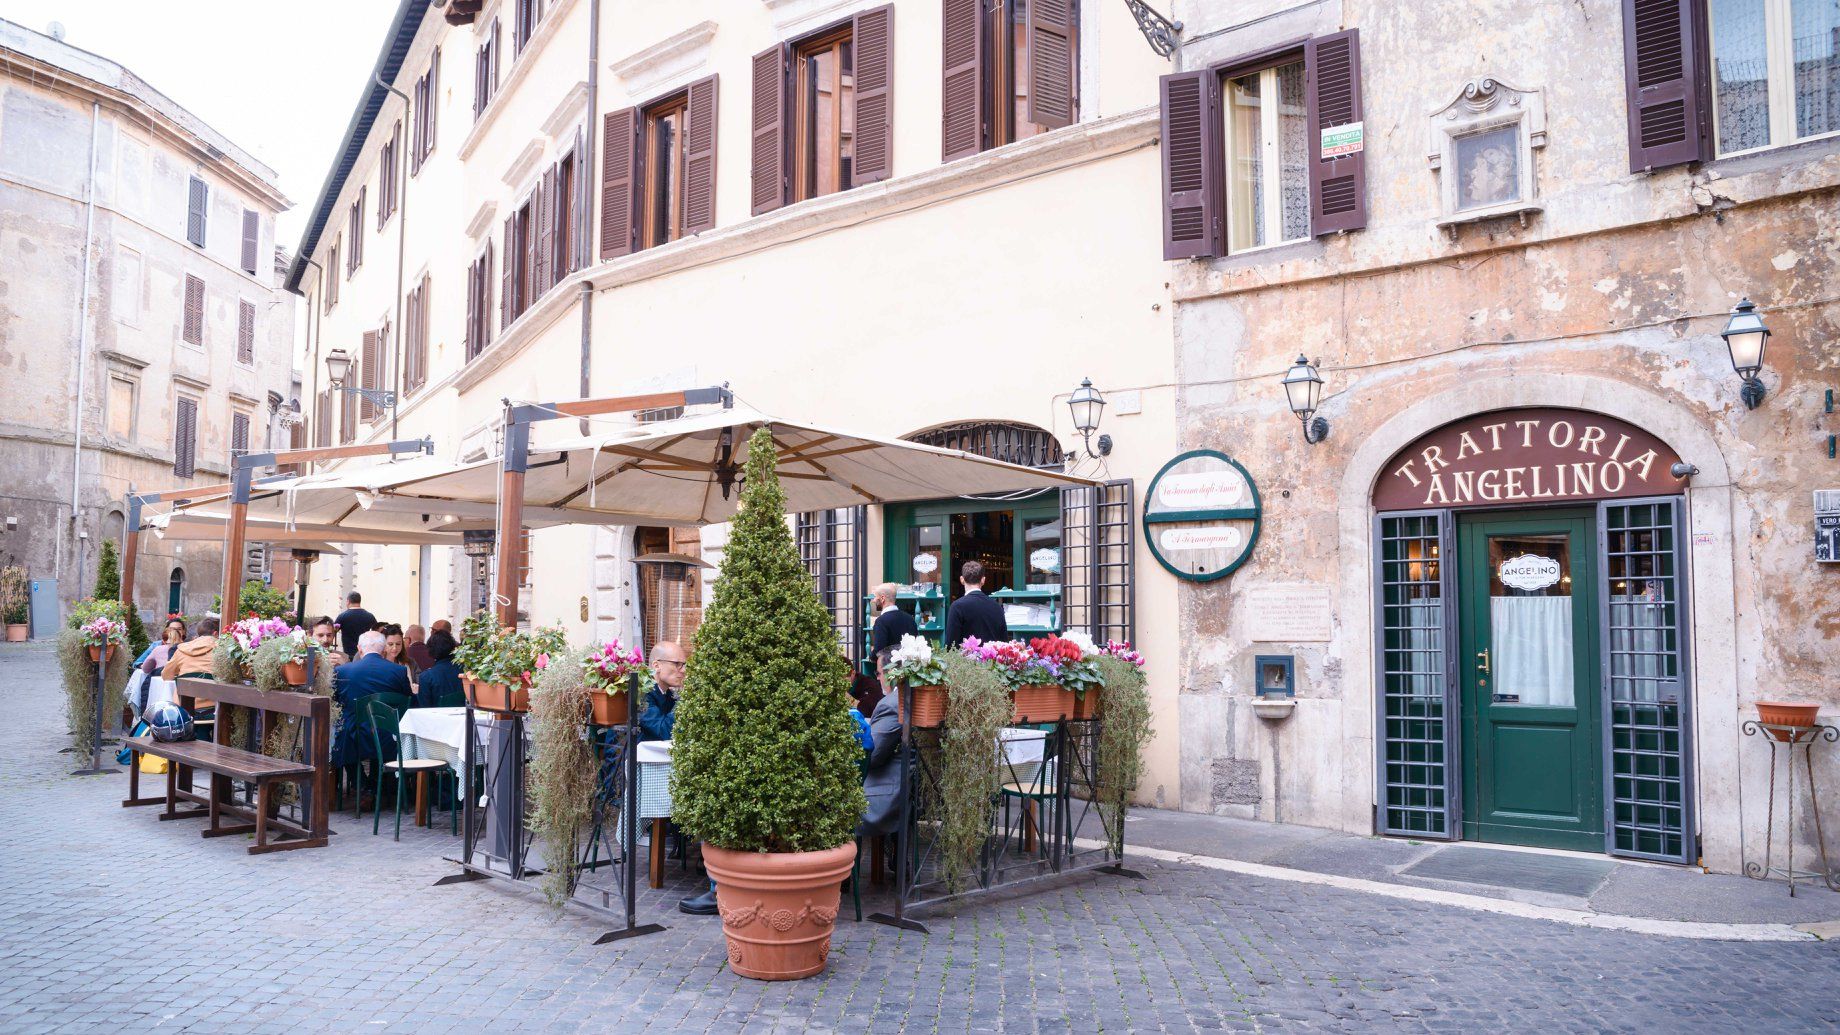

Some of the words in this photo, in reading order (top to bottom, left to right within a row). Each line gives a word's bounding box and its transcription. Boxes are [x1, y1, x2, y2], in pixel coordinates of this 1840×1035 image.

[1332, 131, 1360, 141] VENDITA
[1394, 420, 1659, 489] TRATTORIA
[1423, 460, 1627, 505] ANGELINO
[1504, 566, 1557, 576] ANGELINO
